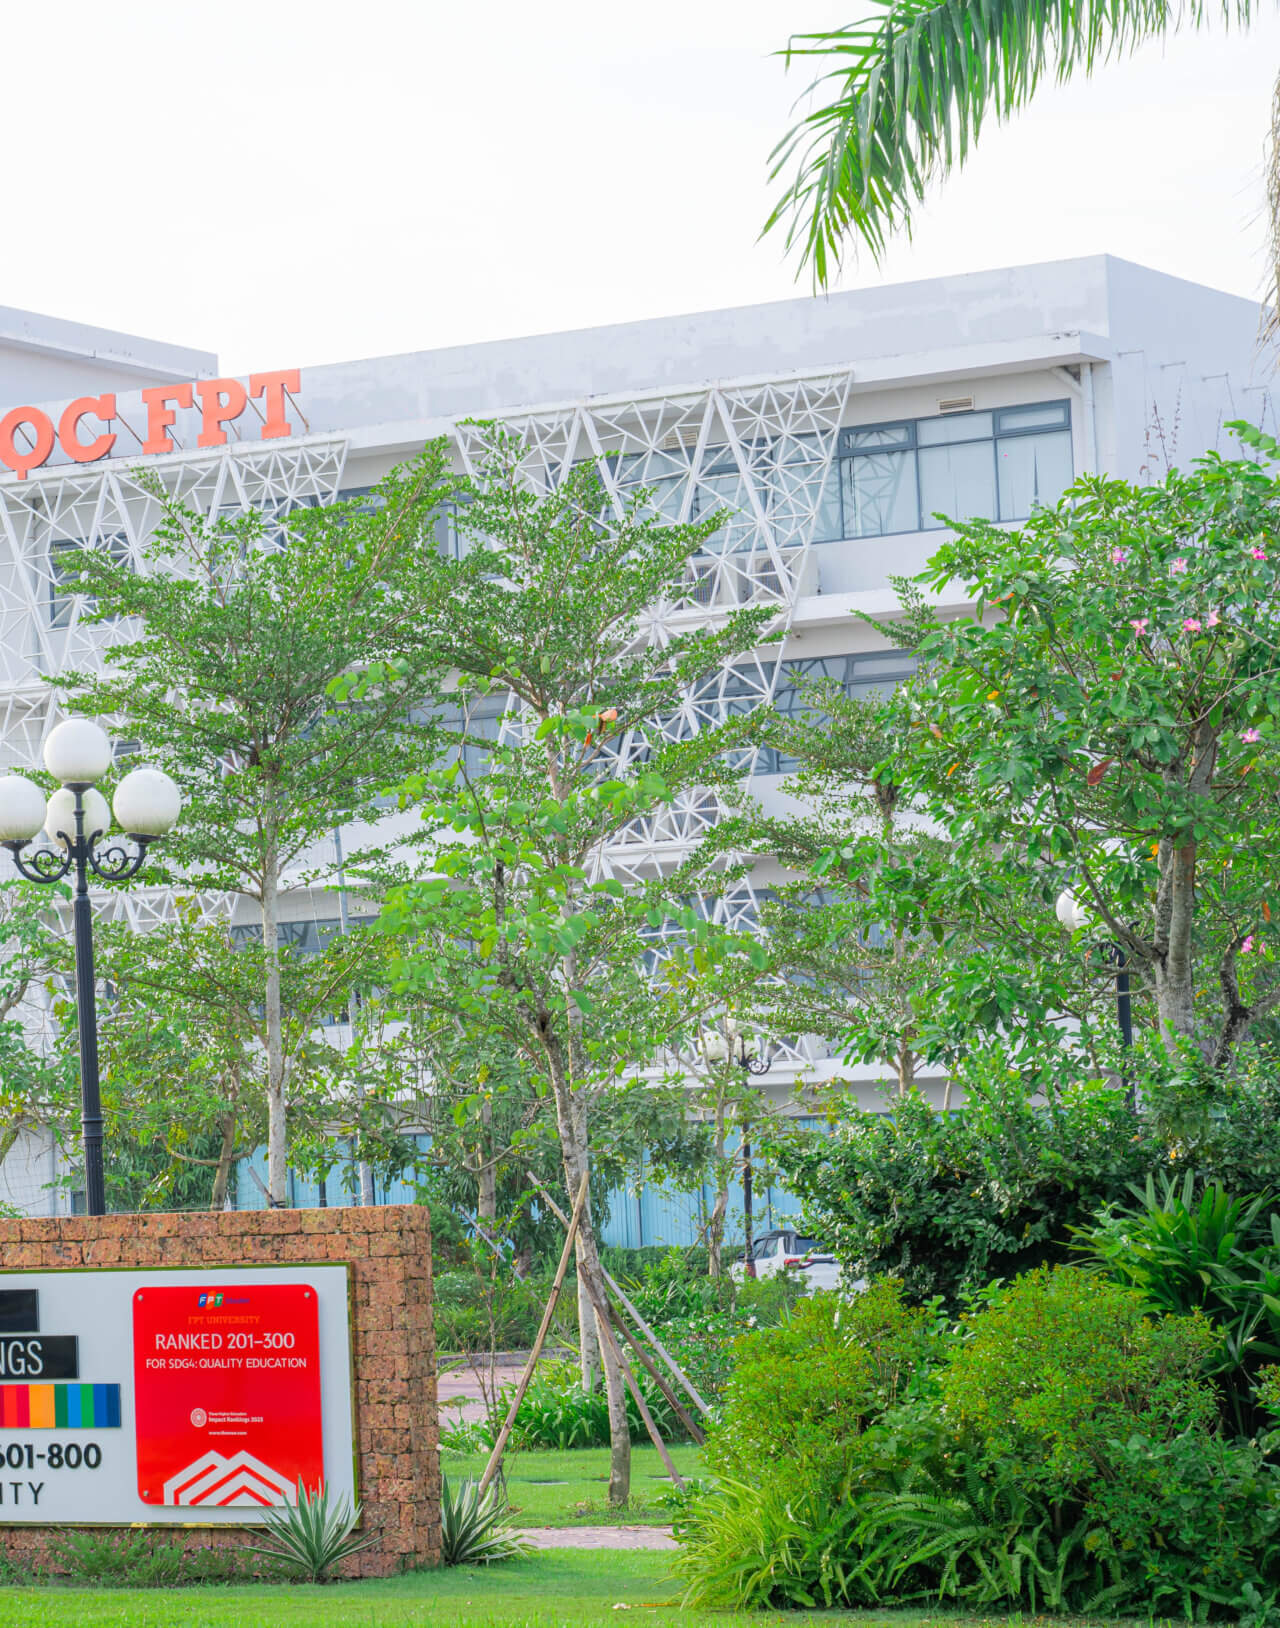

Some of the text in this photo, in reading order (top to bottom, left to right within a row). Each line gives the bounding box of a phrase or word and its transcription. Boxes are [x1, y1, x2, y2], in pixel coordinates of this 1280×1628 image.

[142, 369, 301, 455] FPT
[155, 1333, 223, 1350] RANKED
[146, 1357, 307, 1369] FOR SDG4: QUALITY EDUCATION
